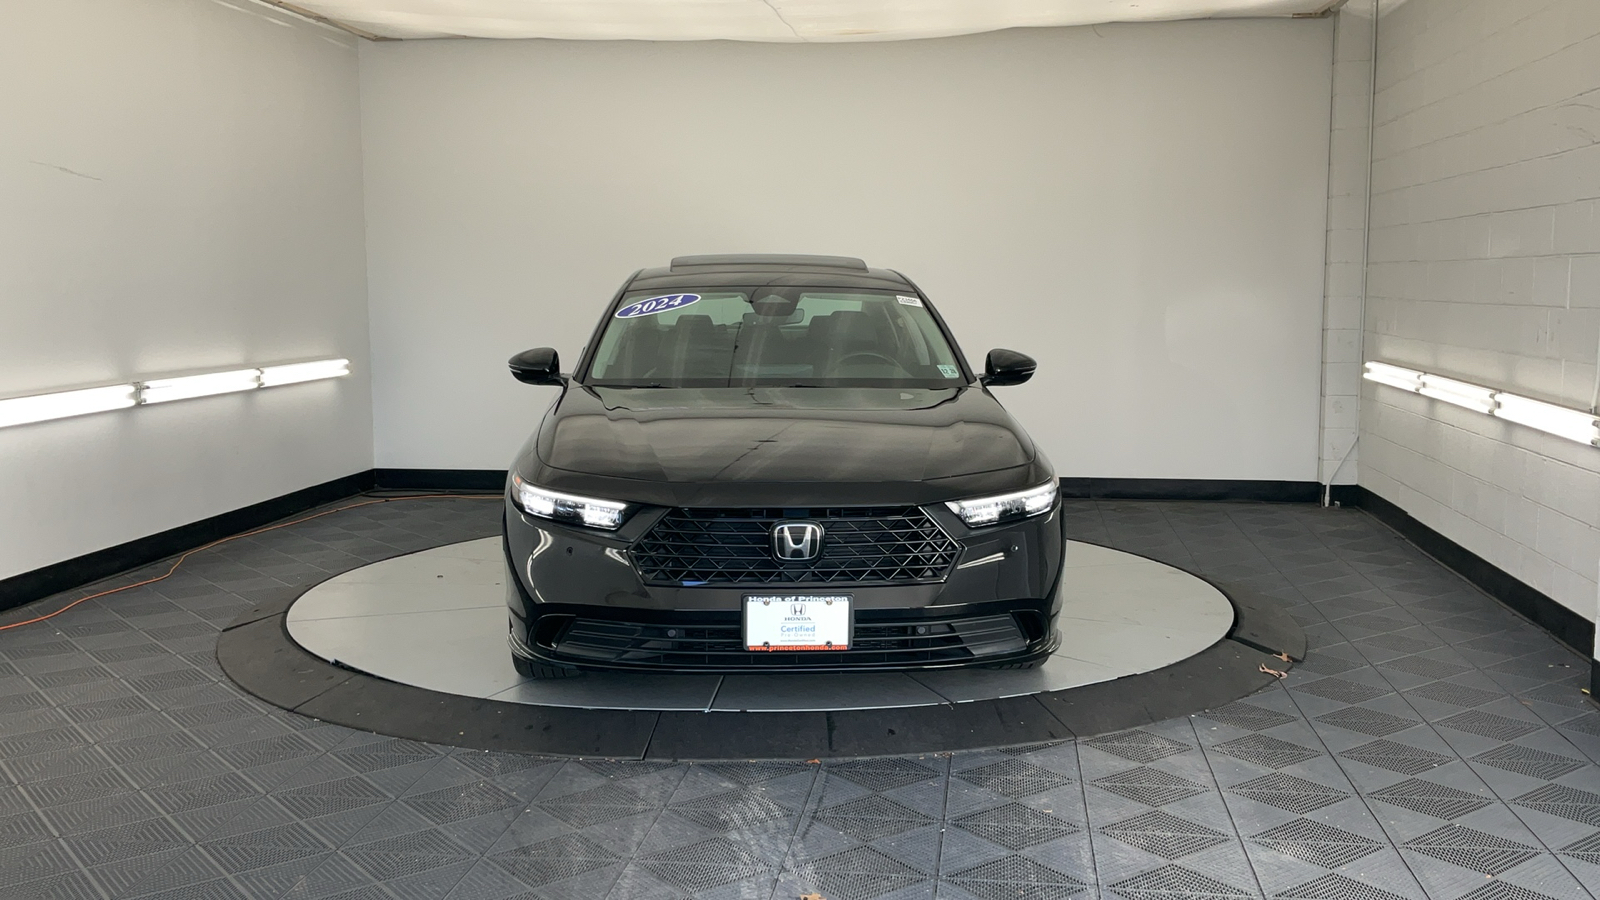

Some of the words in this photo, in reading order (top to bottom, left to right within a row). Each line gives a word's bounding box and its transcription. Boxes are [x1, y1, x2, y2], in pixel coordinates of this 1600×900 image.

[628, 295, 684, 316] 2024
[781, 625, 816, 633] Certified
[748, 645, 848, 653] www.princetonhonda.com
